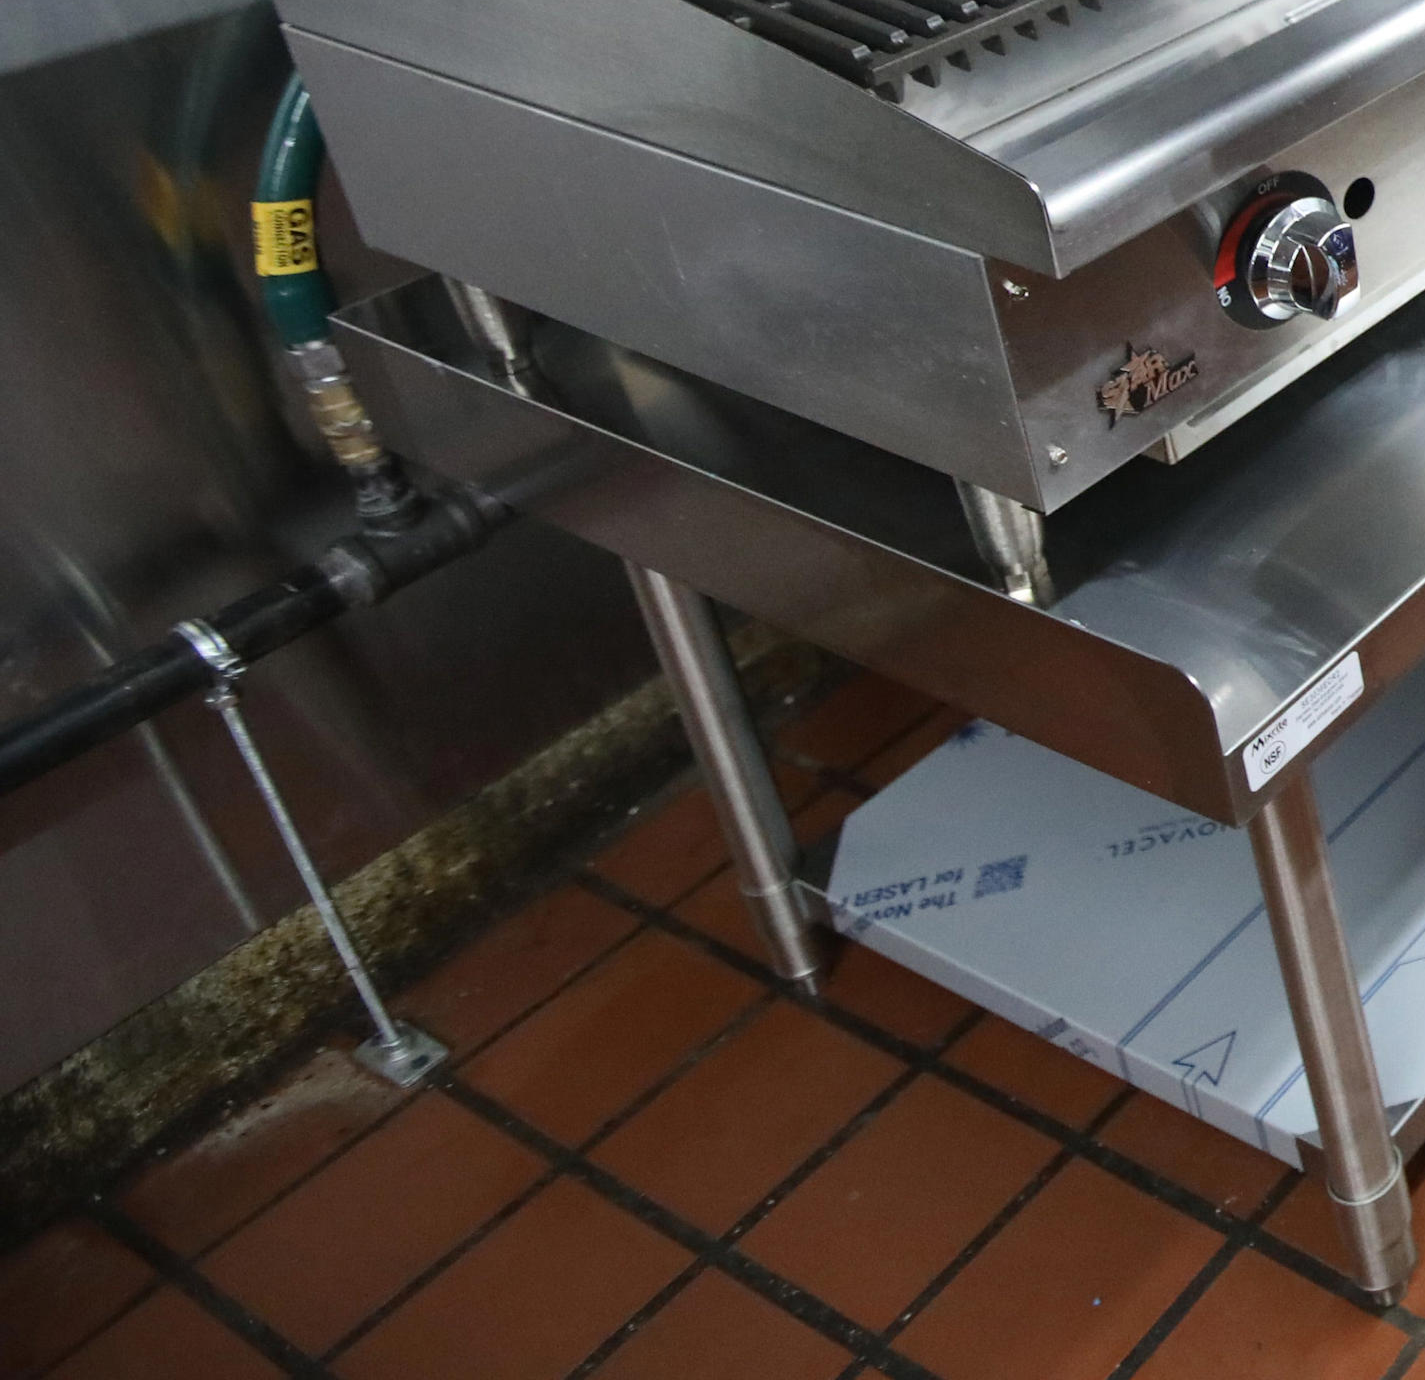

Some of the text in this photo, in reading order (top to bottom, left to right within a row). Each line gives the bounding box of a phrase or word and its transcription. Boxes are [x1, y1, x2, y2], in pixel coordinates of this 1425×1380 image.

[1257, 176, 1280, 196] OFF
[289, 207, 310, 267] GAS
[1216, 285, 1232, 308] ON
[1263, 745, 1282, 769] NSF
[934, 867, 964, 885] for
[854, 877, 927, 907] LASER
[918, 891, 956, 910] The
